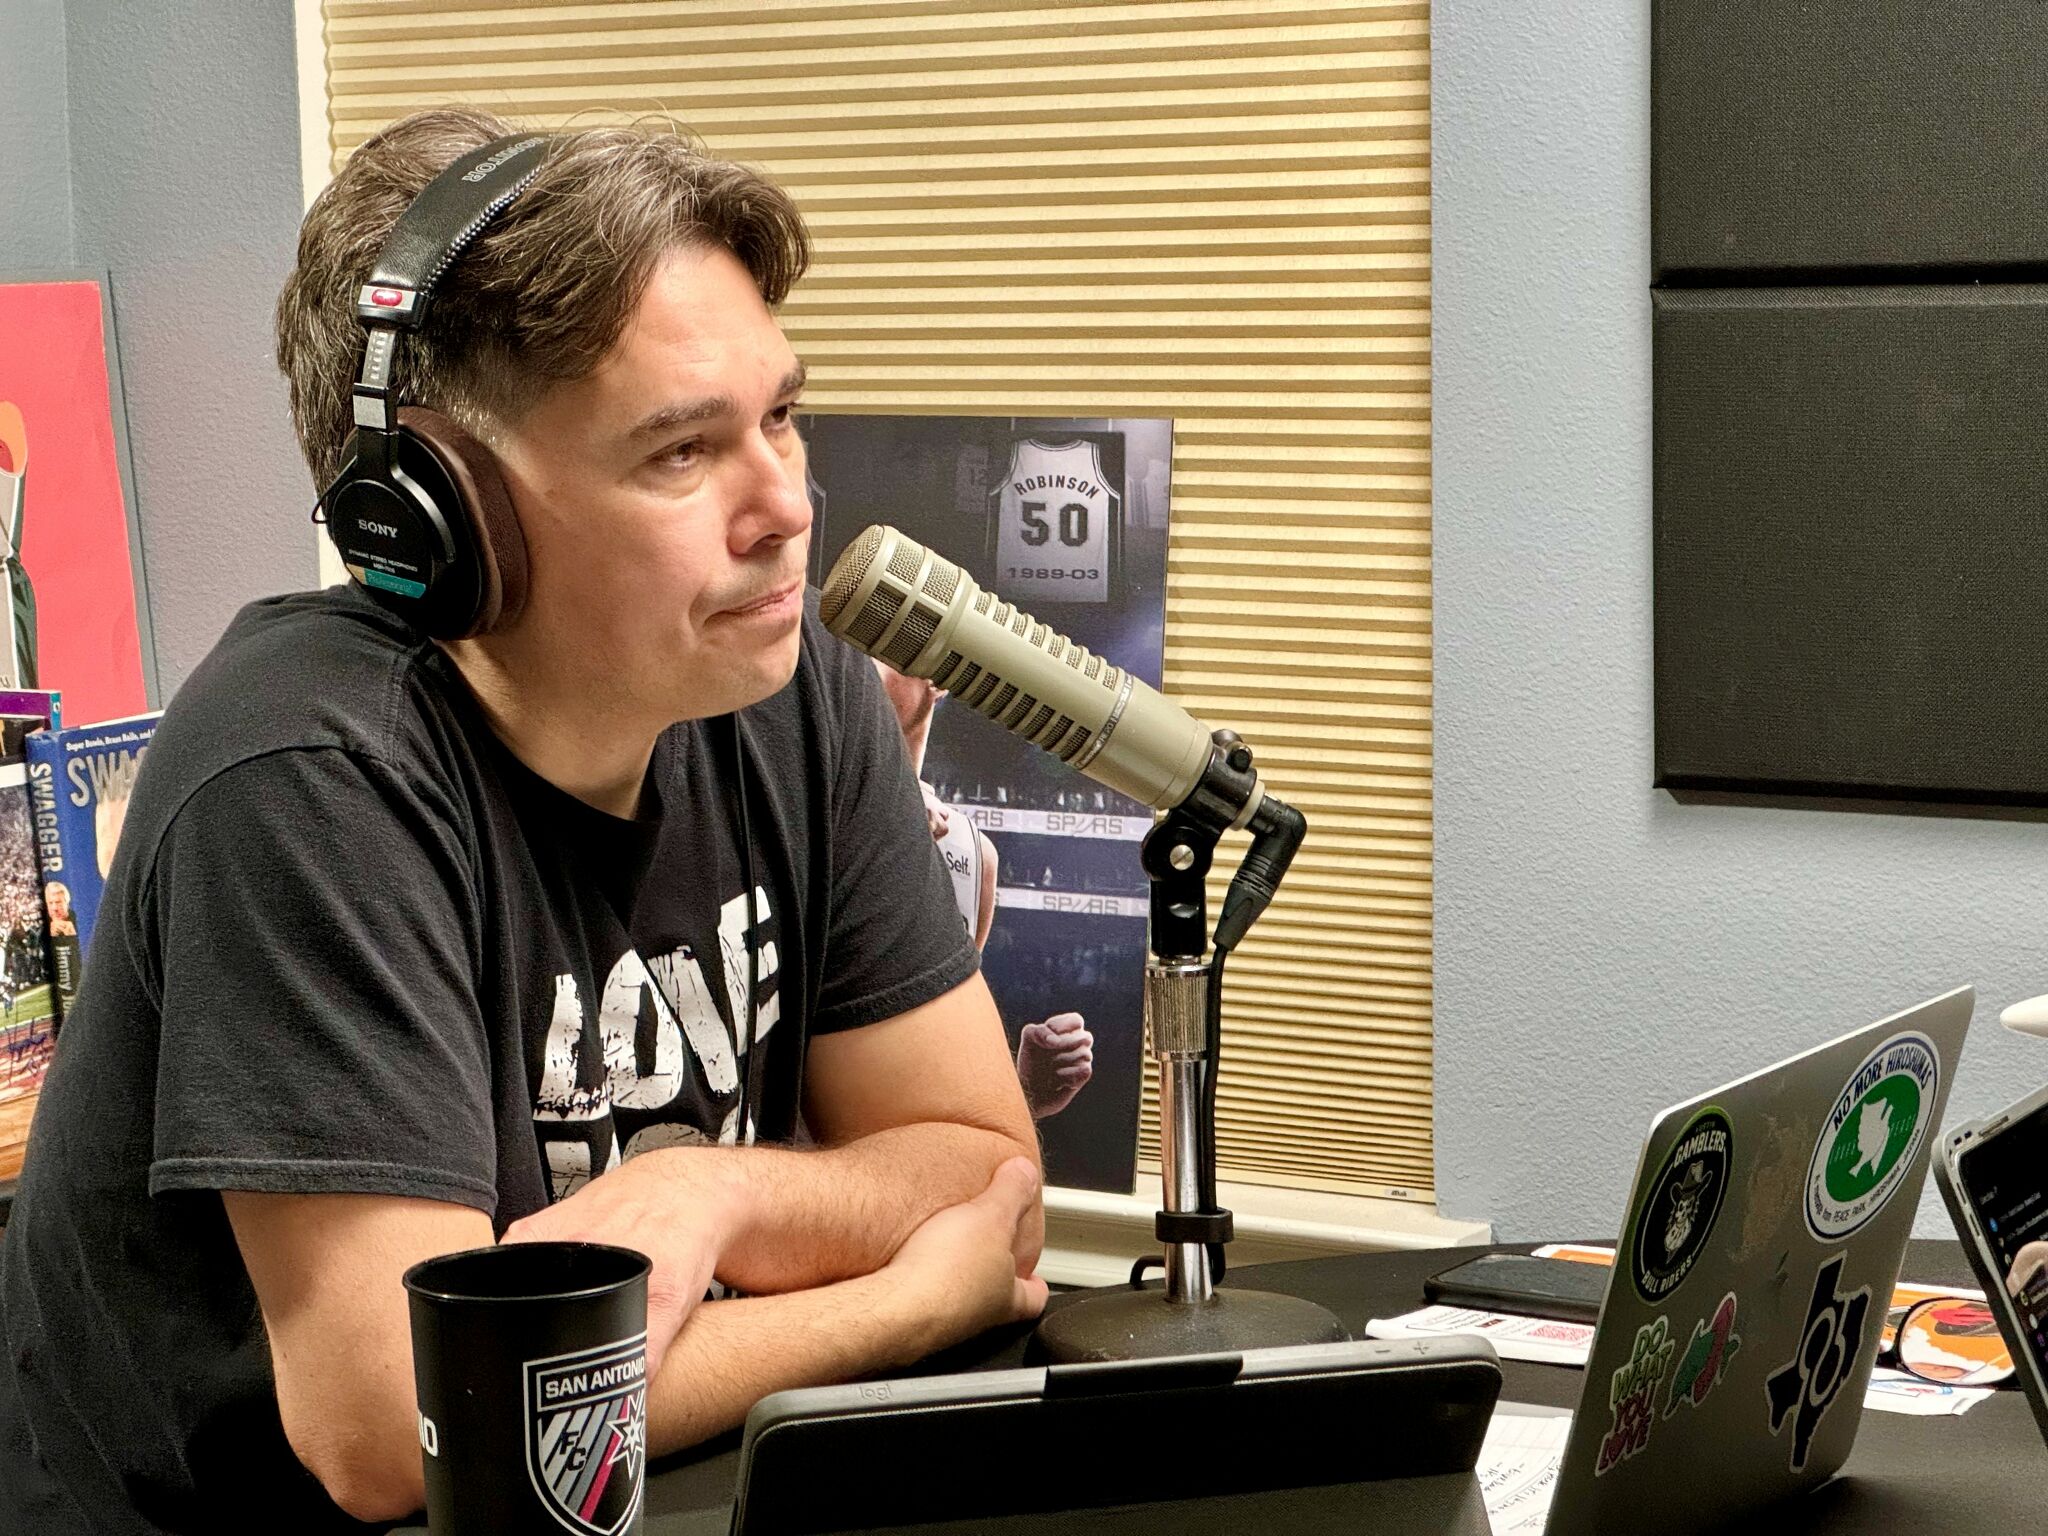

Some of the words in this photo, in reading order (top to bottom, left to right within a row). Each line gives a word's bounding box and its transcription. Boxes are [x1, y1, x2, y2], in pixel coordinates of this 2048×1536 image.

[1014, 475, 1100, 499] ROBINSON
[358, 519, 398, 538] SONY
[1021, 501, 1088, 547] 50
[1008, 567, 1100, 580] 1989-03
[29, 762, 64, 873] SWAGGER
[945, 851, 971, 876] Self.
[1833, 1095, 1851, 1131] NO
[1853, 1058, 1884, 1102] MORE
[1673, 1130, 1727, 1168] GAMBLERS
[1641, 1270, 1658, 1293] BULL
[1660, 1255, 1692, 1293] RIDERS
[1632, 1320, 1666, 1364] DO
[545, 1375, 588, 1399] SAN
[590, 1355, 646, 1390] ANTONIO
[858, 1382, 893, 1401] logi
[1612, 1342, 1674, 1405] WHAT
[1598, 1411, 1653, 1471] LOVE
